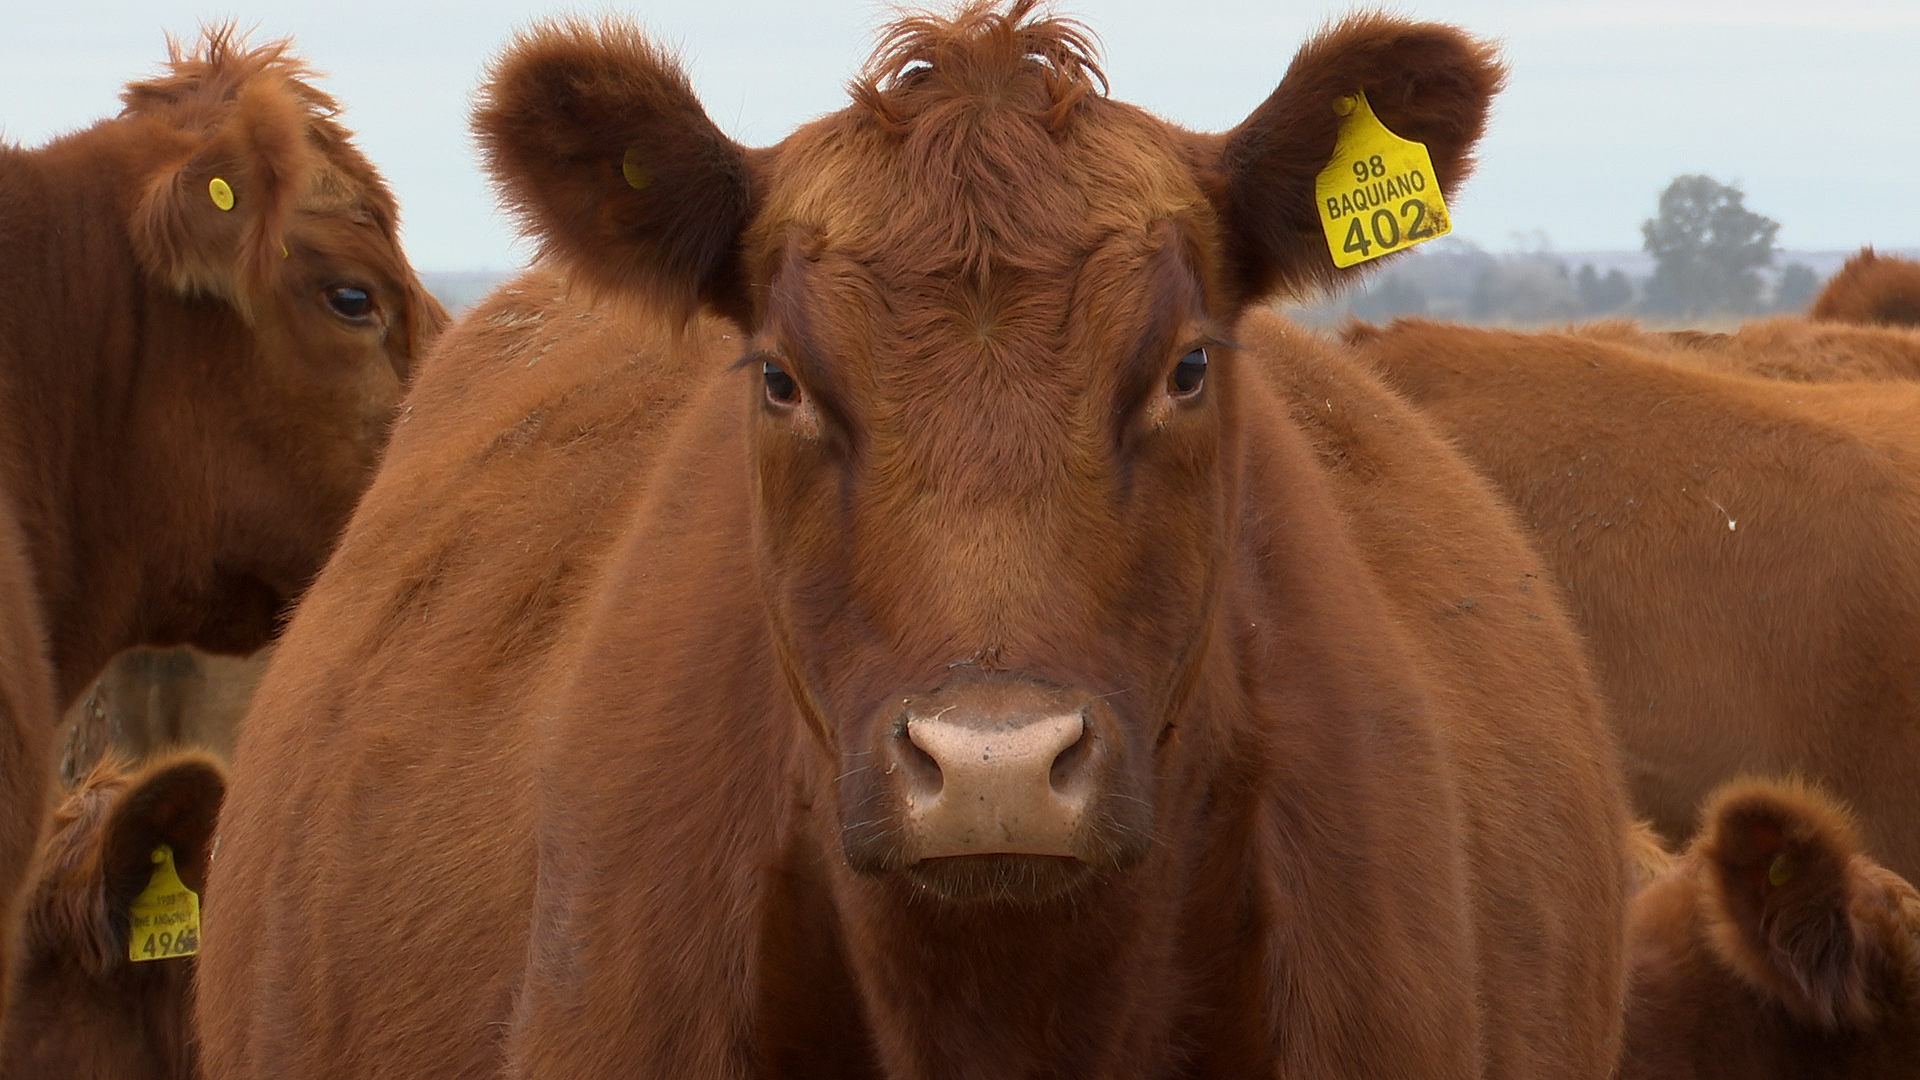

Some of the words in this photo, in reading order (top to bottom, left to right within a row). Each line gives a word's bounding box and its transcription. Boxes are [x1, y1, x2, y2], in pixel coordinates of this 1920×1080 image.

[1352, 154, 1386, 183] 98
[1326, 169, 1425, 220] BAQUIANO
[1343, 198, 1434, 256] 402
